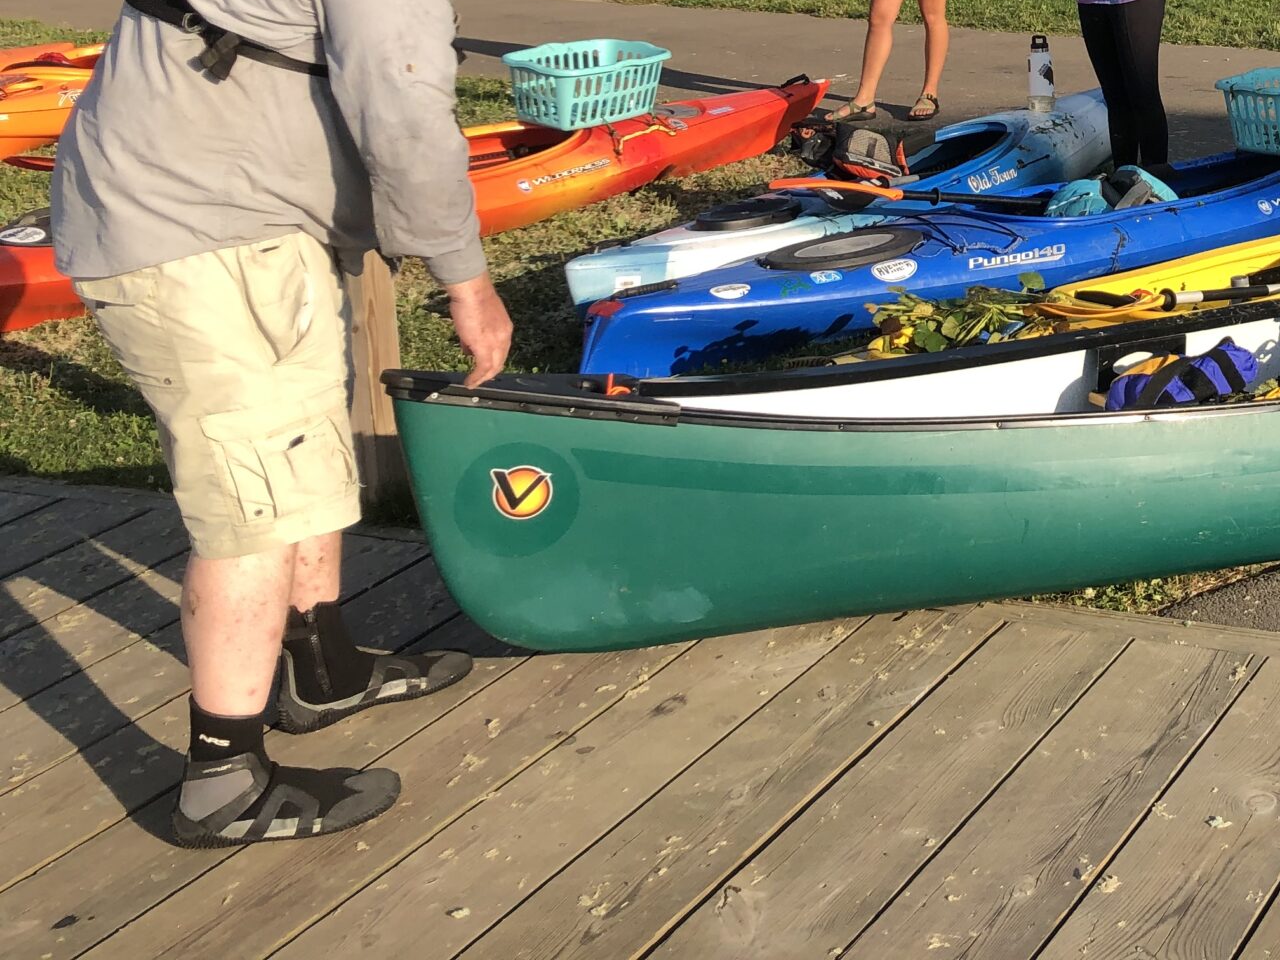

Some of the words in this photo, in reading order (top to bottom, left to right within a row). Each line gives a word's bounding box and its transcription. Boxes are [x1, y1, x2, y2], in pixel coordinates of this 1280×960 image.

[532, 159, 611, 186] WILDERNESS
[968, 171, 992, 193] Old
[989, 165, 1018, 186] Town
